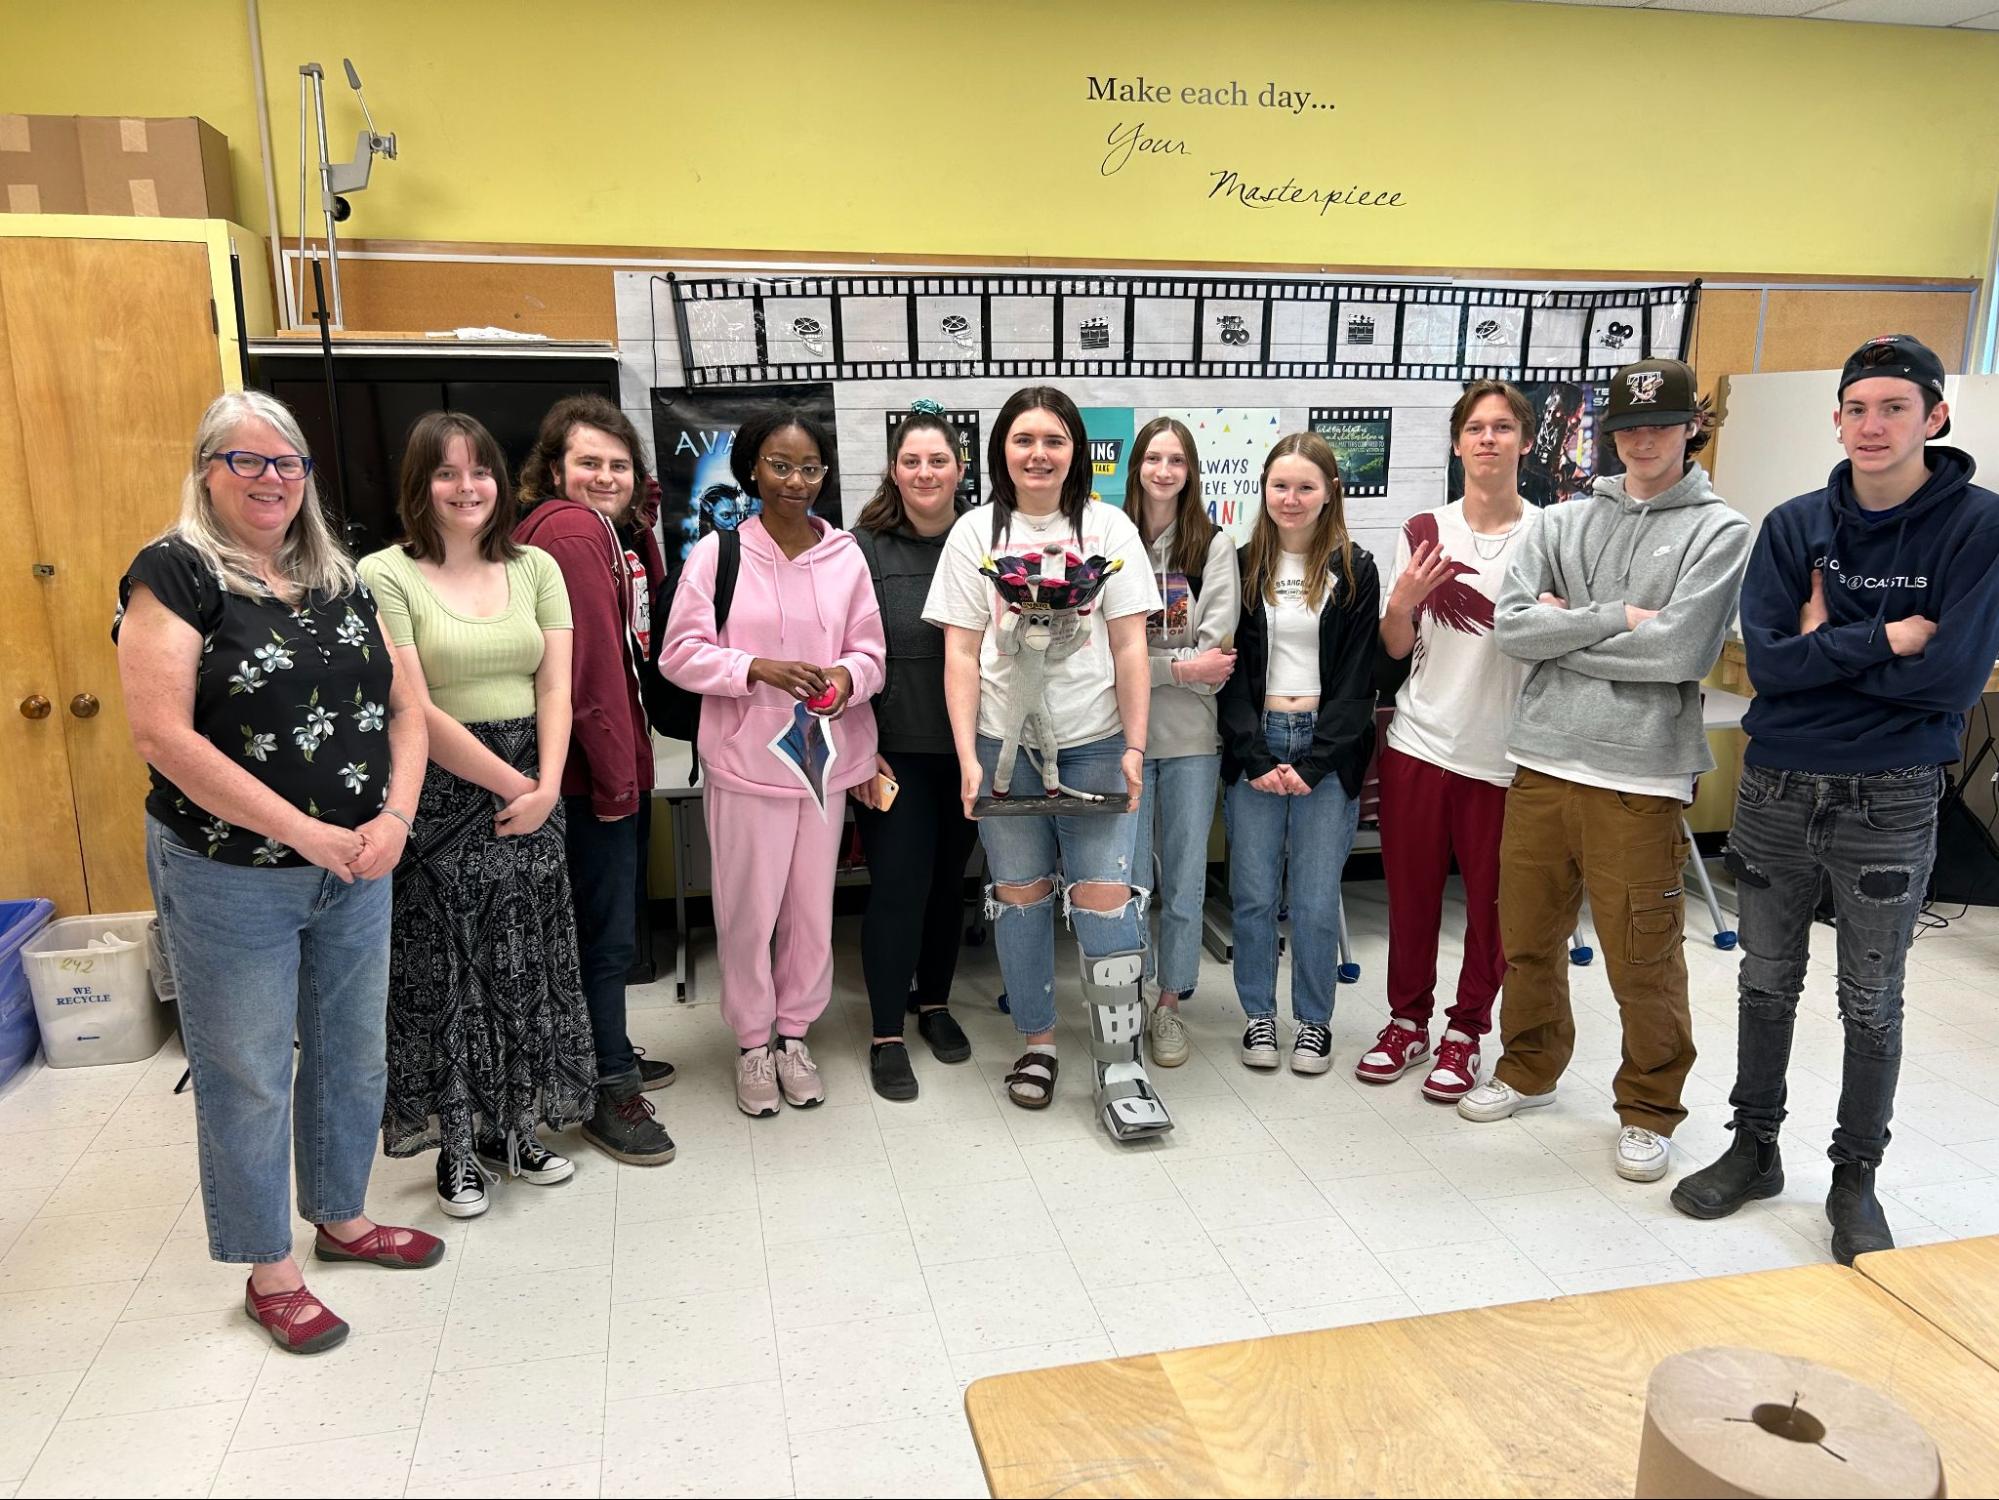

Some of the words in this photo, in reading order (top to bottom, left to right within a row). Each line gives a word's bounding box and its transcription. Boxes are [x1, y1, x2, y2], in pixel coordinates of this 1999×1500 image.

[1086, 76, 1171, 104] Make
[1180, 81, 1249, 107] each
[1257, 83, 1336, 115] day...
[1100, 122, 1192, 177] Your
[1208, 169, 1407, 216] Masterpiece
[674, 429, 737, 458] AVA
[1199, 458, 1249, 475] LWAYS
[1233, 479, 1259, 495] YOU
[1206, 500, 1244, 525] AN!
[61, 957, 95, 974] 242
[56, 995, 111, 1005] RECYCLE
[73, 986, 92, 995] WE
